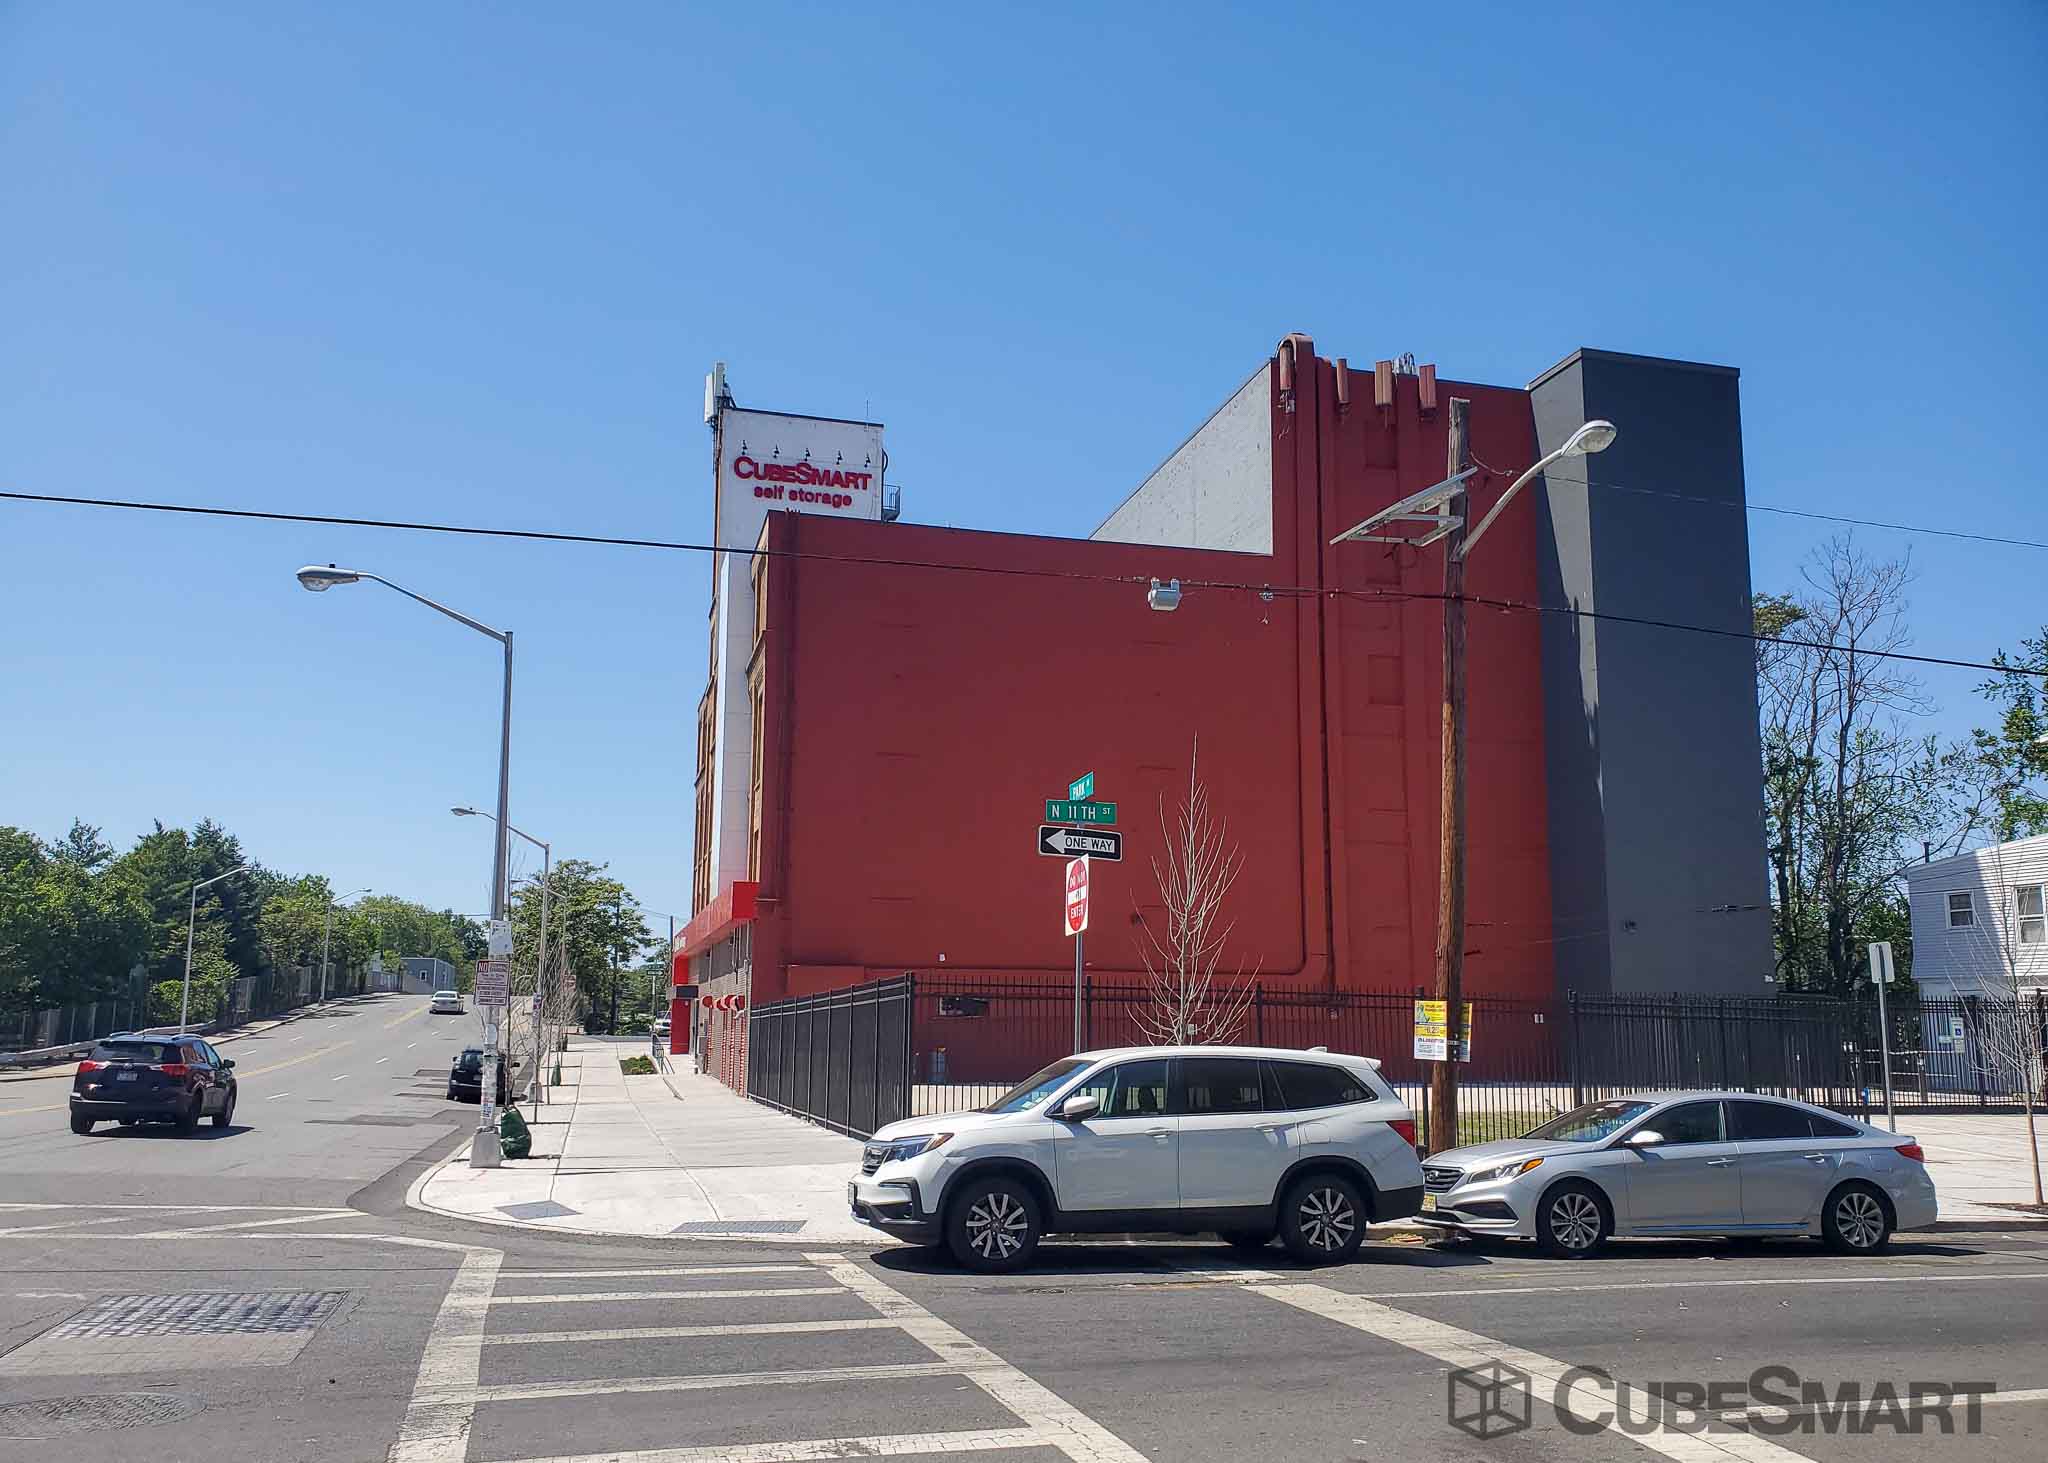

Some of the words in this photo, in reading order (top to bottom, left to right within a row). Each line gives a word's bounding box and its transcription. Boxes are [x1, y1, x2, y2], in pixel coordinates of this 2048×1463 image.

[734, 456, 872, 490] CUBESMART
[754, 485, 785, 500] self
[788, 487, 852, 508] storage
[1051, 804, 1060, 818] N
[1102, 807, 1111, 815] ST
[1065, 836, 1088, 849] ONE
[1091, 839, 1113, 851] WAY
[478, 962, 488, 972] NO
